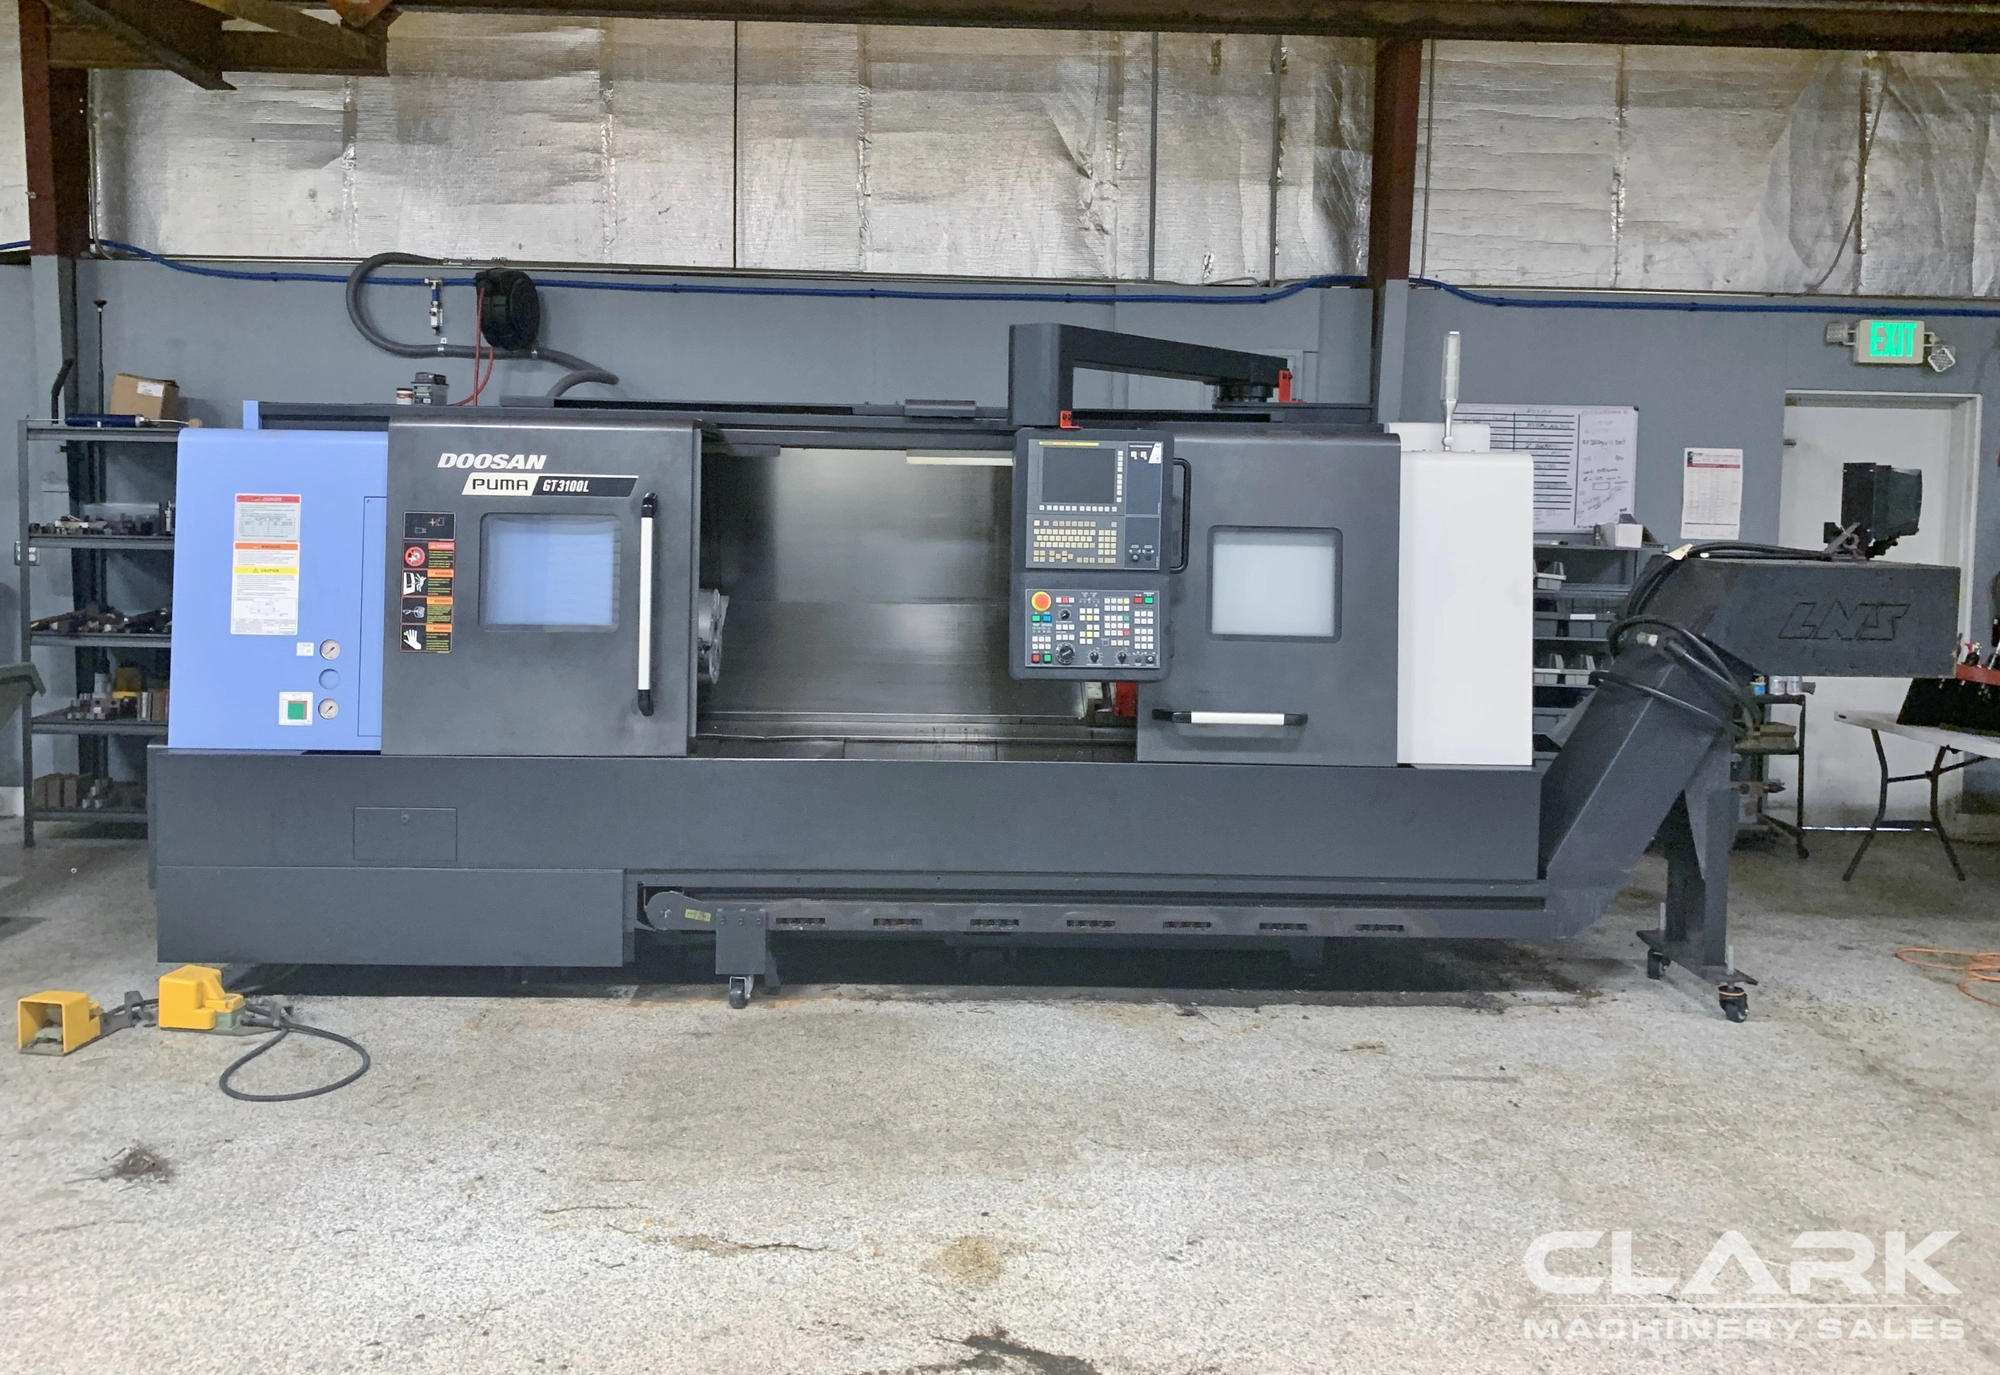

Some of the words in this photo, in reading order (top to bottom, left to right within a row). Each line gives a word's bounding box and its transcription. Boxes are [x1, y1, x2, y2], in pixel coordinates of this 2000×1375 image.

[1870, 322, 1917, 357] EXIT
[437, 453, 547, 469] DOOSAN
[472, 479, 528, 491] PUMA
[543, 480, 589, 493] GT3100L
[1778, 600, 1911, 641] LNS
